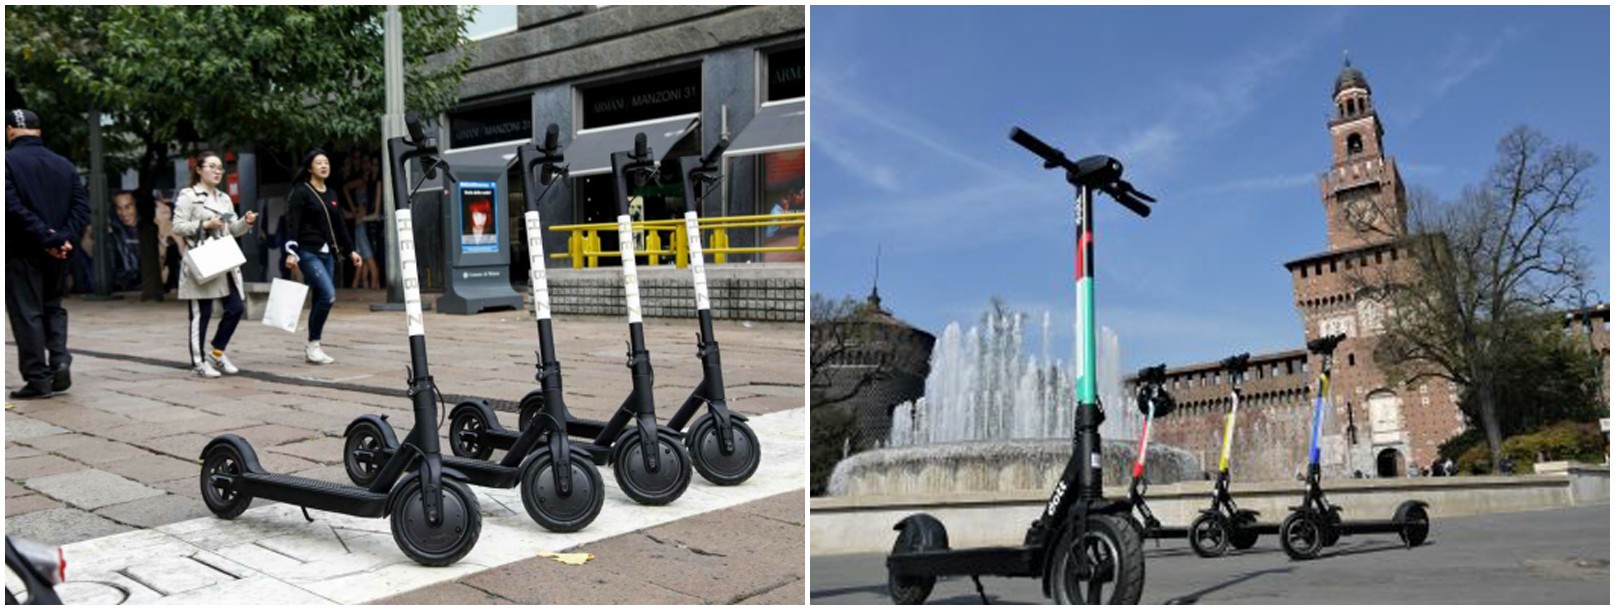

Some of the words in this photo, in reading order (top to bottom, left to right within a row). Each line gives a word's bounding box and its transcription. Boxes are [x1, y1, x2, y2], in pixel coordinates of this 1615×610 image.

[631, 87, 682, 108] MANZONI
[683, 84, 697, 99] 31
[770, 65, 805, 84] ARM
[398, 218, 422, 326] HELBIZ
[527, 218, 550, 312] HELBIZ
